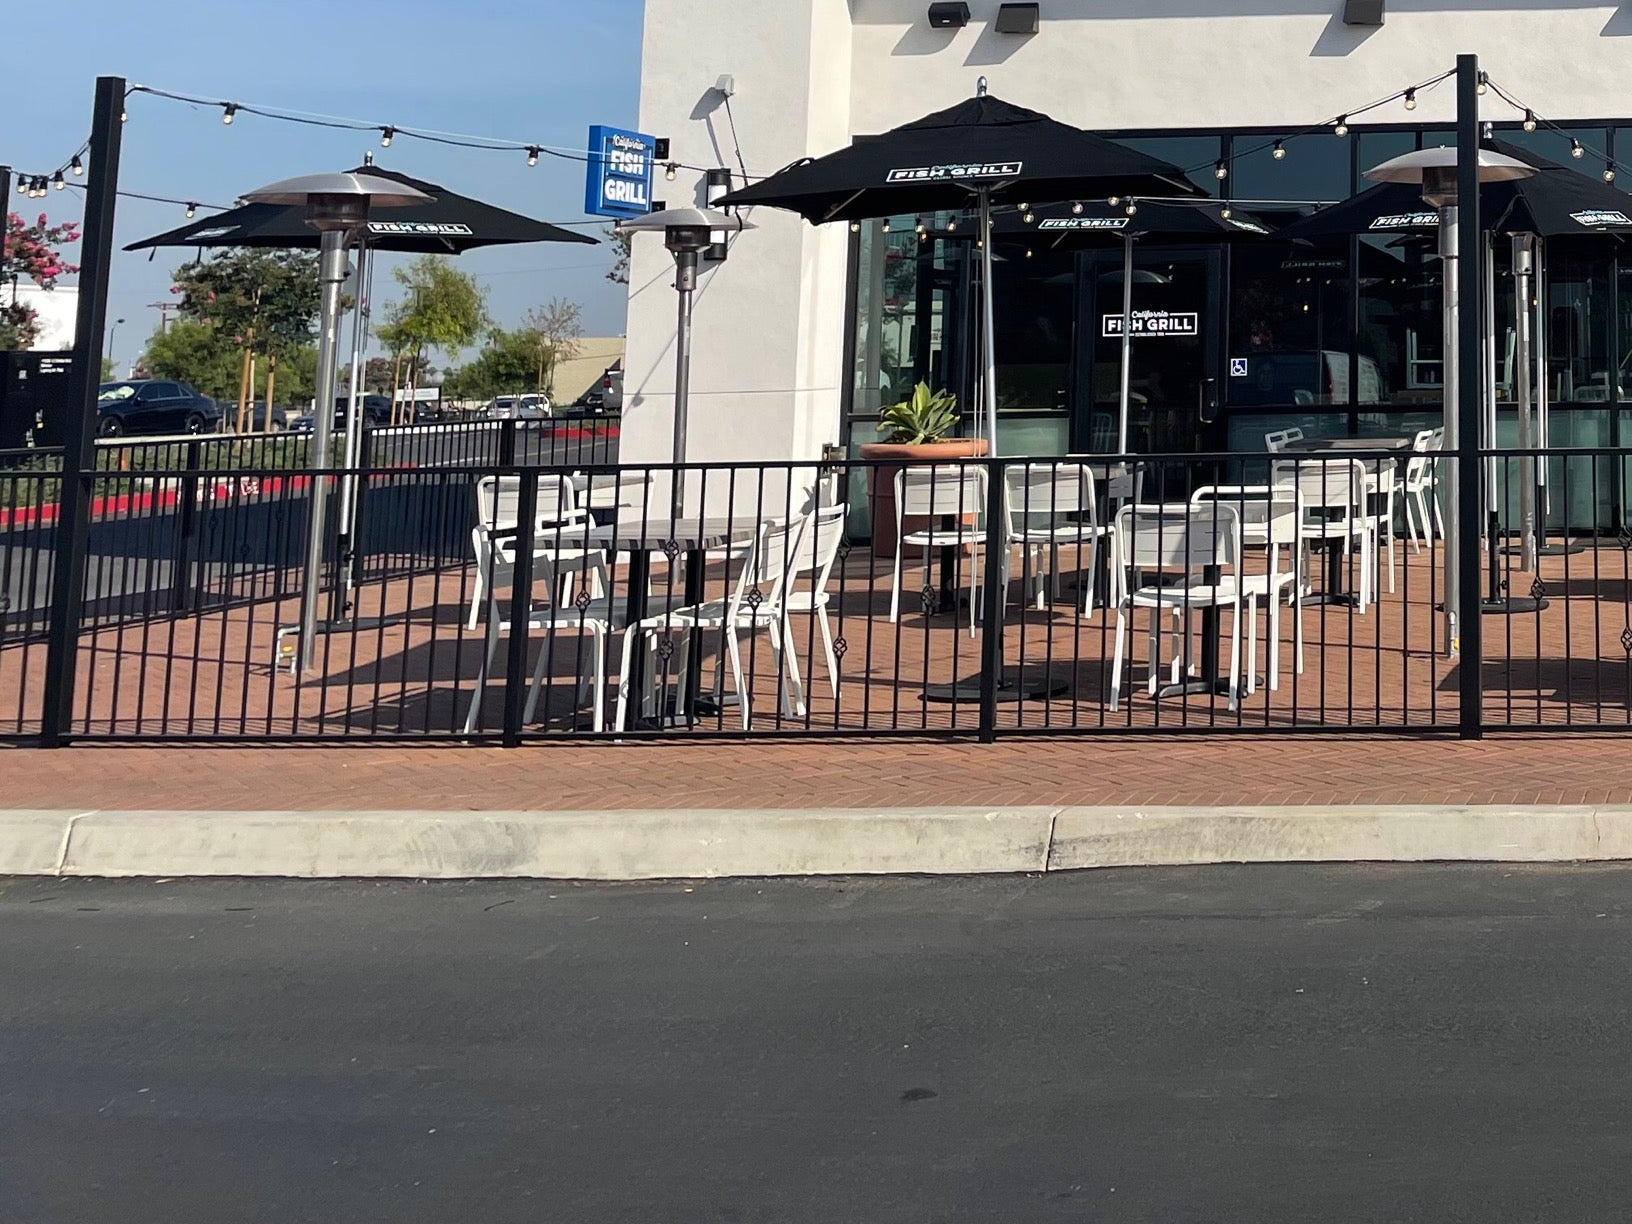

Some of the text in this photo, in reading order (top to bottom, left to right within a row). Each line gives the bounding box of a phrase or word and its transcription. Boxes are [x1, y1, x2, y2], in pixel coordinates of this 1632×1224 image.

[611, 150, 644, 175] FISH
[894, 168, 944, 179] FISH
[950, 165, 1014, 176] GRILL
[605, 179, 646, 204] GRILL
[1376, 215, 1439, 226] FISH GRI
[1147, 318, 1192, 330] GRILL
